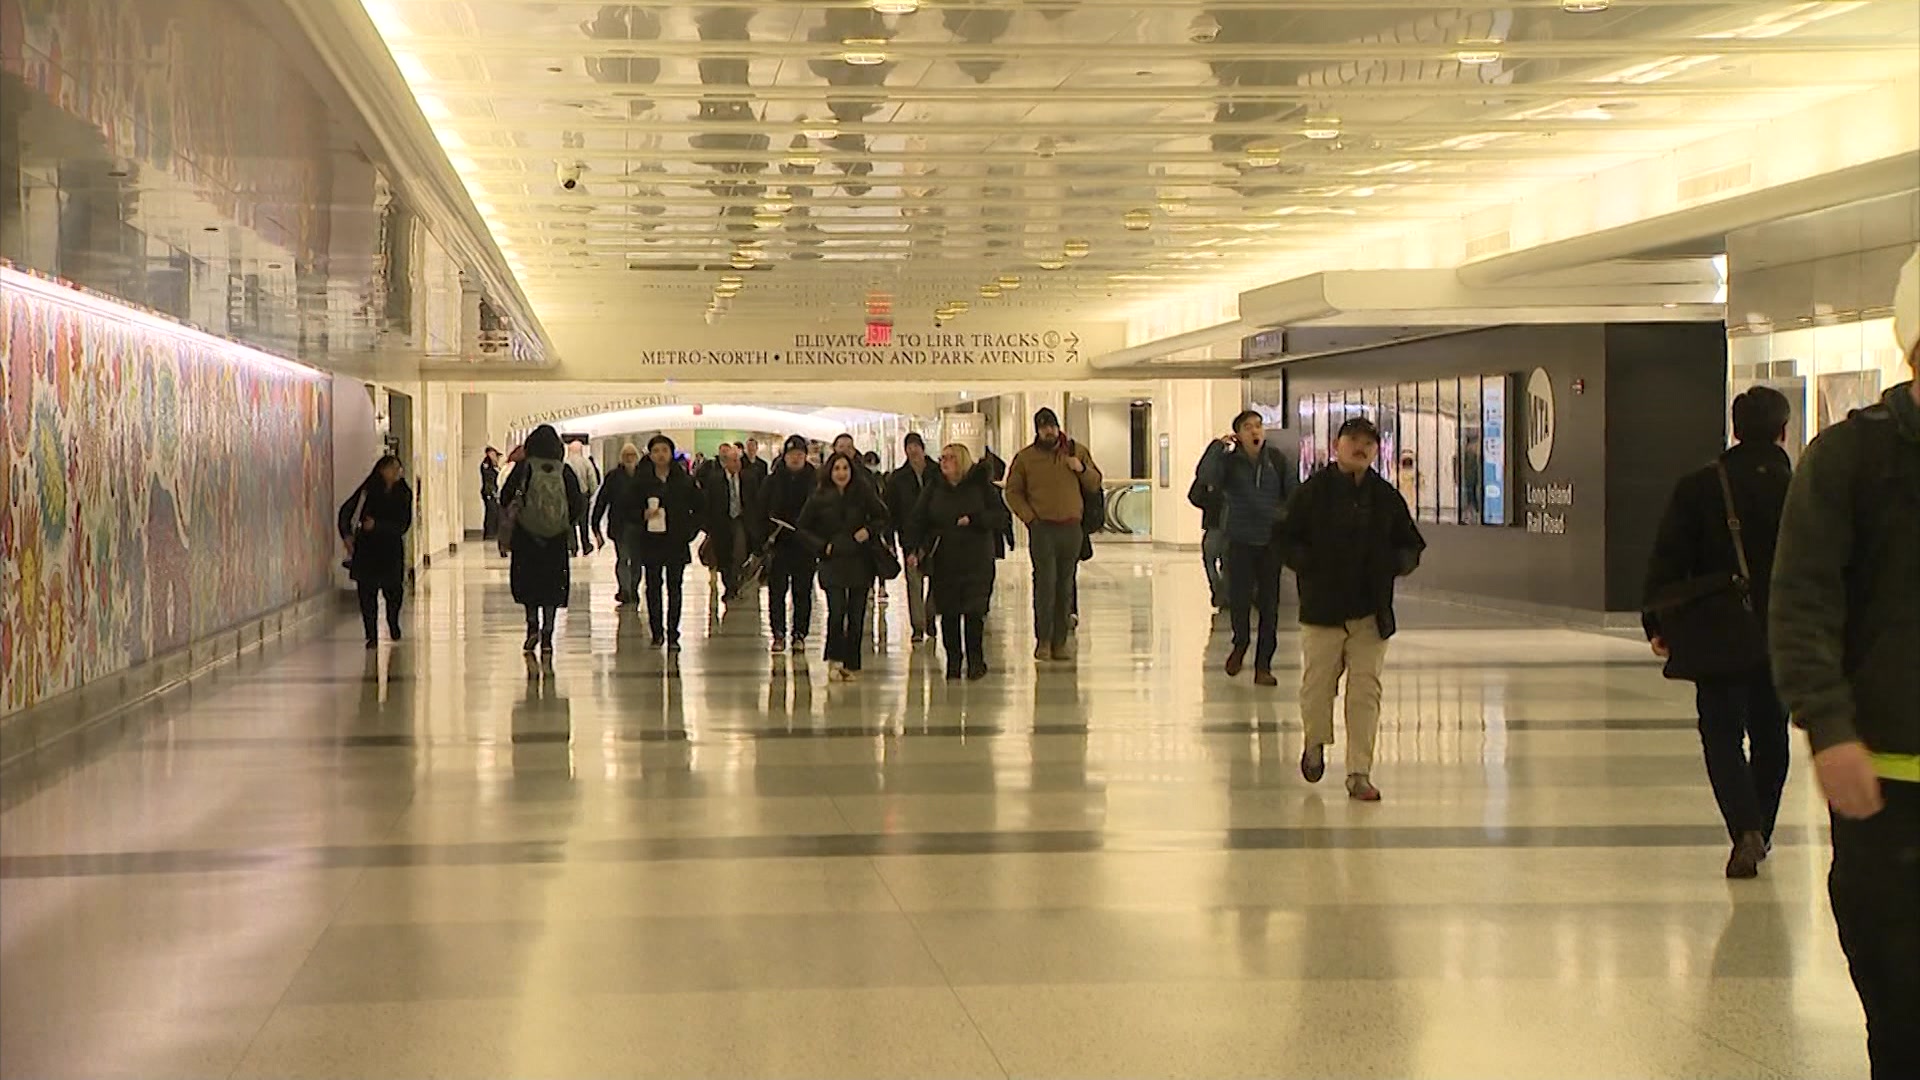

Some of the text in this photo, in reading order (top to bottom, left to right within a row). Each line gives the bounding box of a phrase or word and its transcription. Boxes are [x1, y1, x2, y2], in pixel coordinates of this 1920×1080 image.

[795, 333, 1040, 348] ELEVATO TO LIRR TRACKS
[641, 349, 1056, 365] METRO-NORTH LEXINGTON AND PARK AVENUES
[520, 406, 581, 426] ELEVATOR
[583, 402, 601, 414] TO
[1526, 482, 1572, 509] Long Island
[1527, 511, 1564, 534] Rail Road
